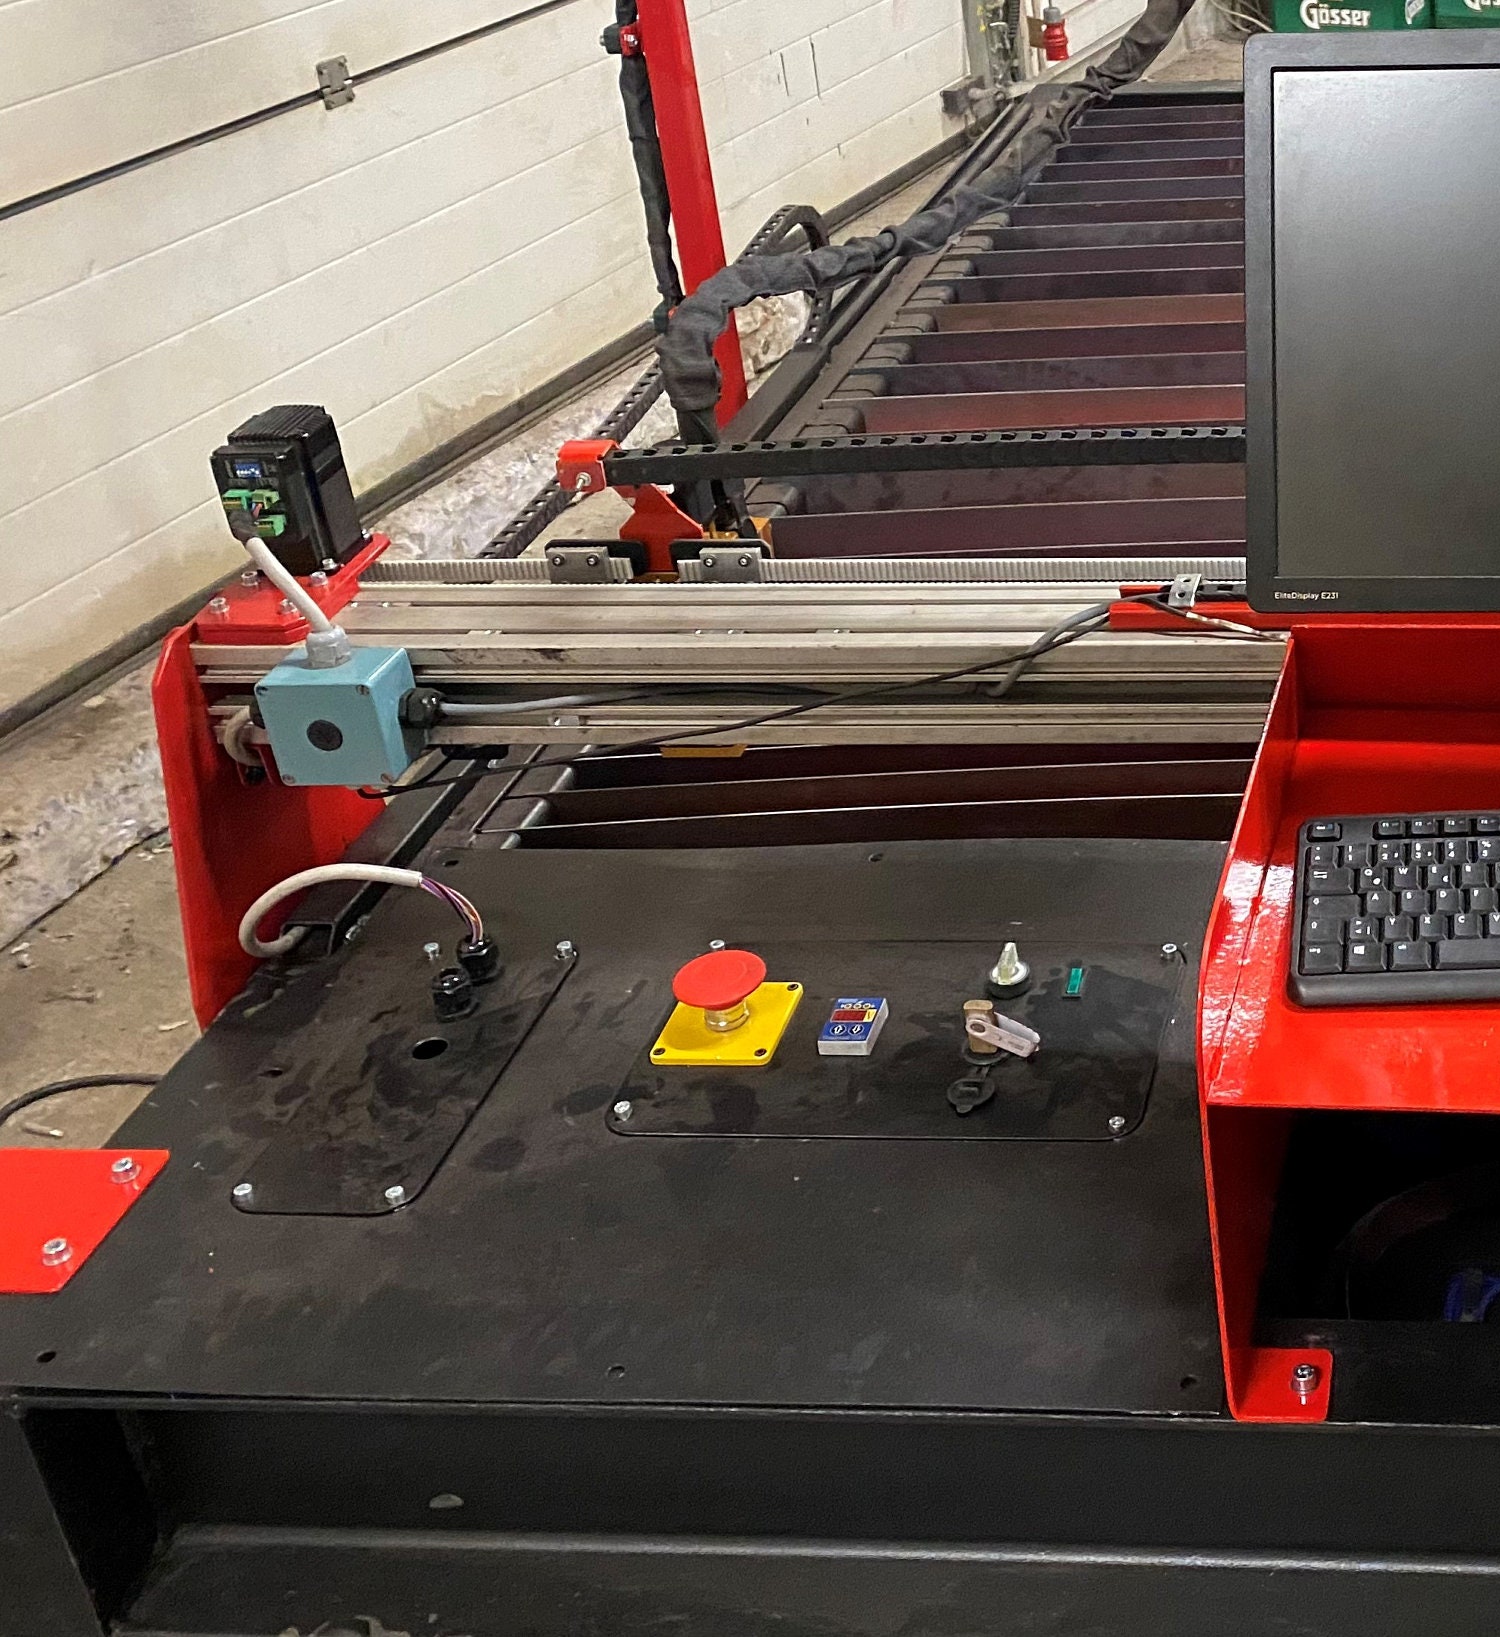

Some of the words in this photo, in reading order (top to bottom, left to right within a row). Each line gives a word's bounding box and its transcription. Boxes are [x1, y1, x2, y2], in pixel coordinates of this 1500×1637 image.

[1299, 0, 1371, 29] Gösser
[1274, 591, 1320, 601] EliteDisplay
[1320, 591, 1339, 600] E231
